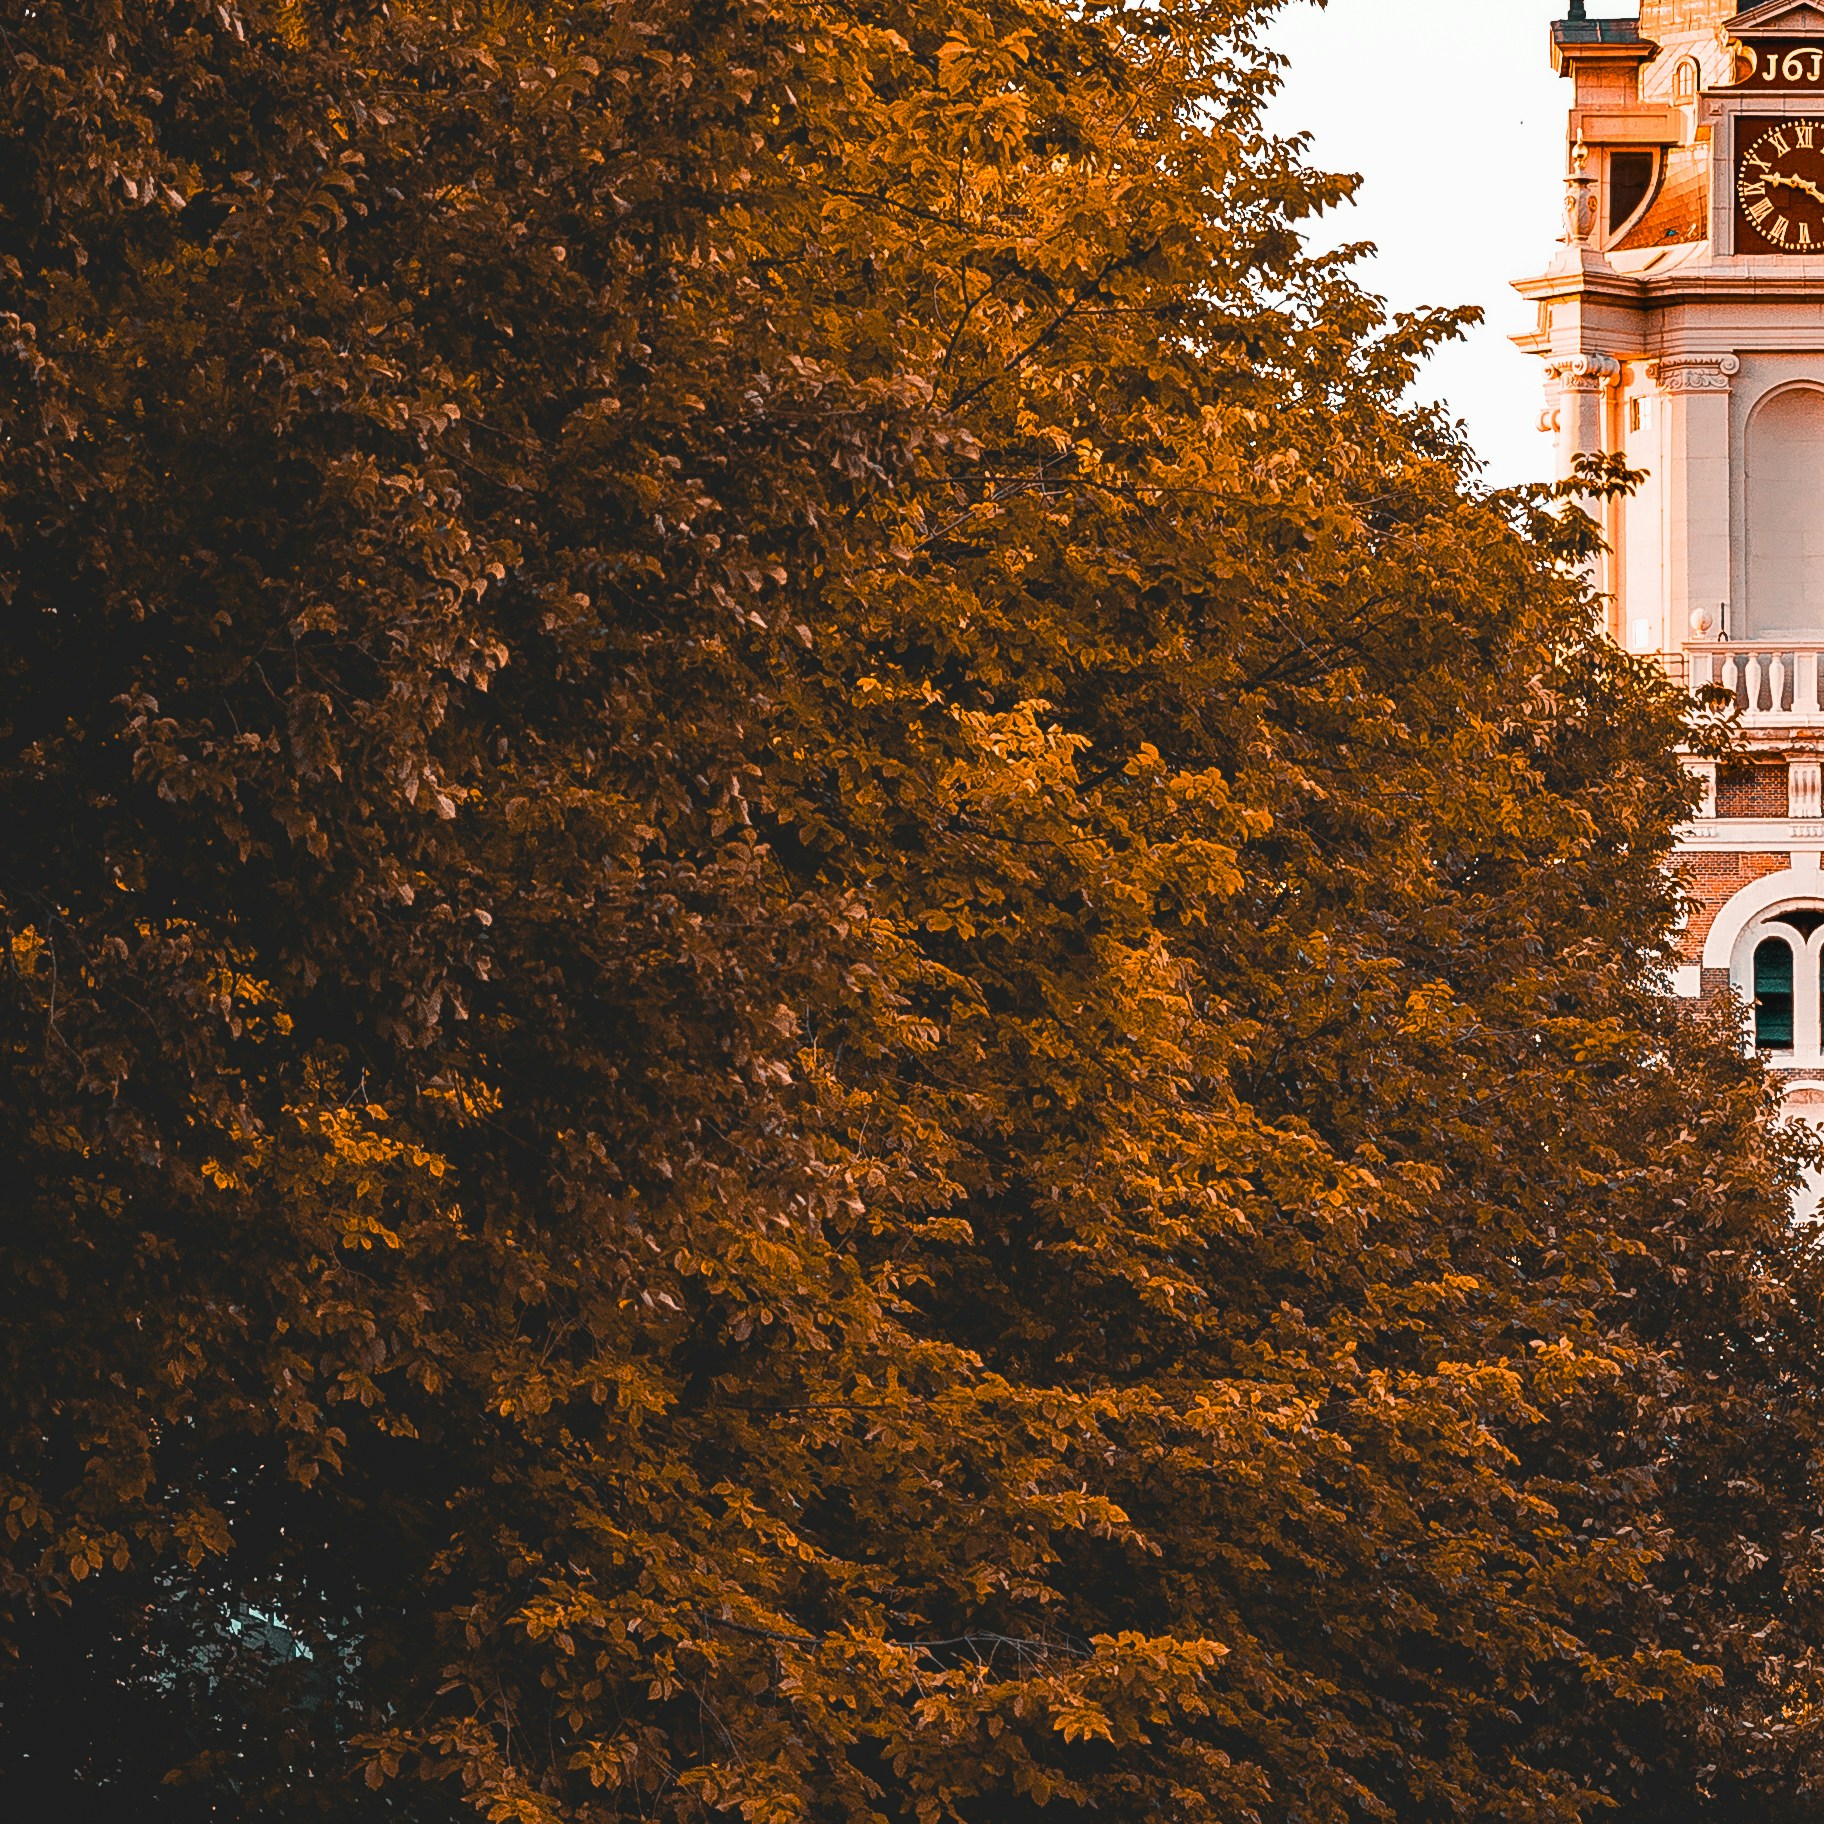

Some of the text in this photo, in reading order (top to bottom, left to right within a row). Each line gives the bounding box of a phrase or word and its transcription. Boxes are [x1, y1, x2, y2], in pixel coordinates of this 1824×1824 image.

[1768, 131, 1791, 158] XI
[1795, 126, 1813, 149] XII
[1748, 153, 1772, 173] X
[1743, 181, 1765, 196] IX
[1748, 196, 1775, 224] VIII
[1770, 215, 1789, 242] VII
[1798, 222, 1811, 243] VI
